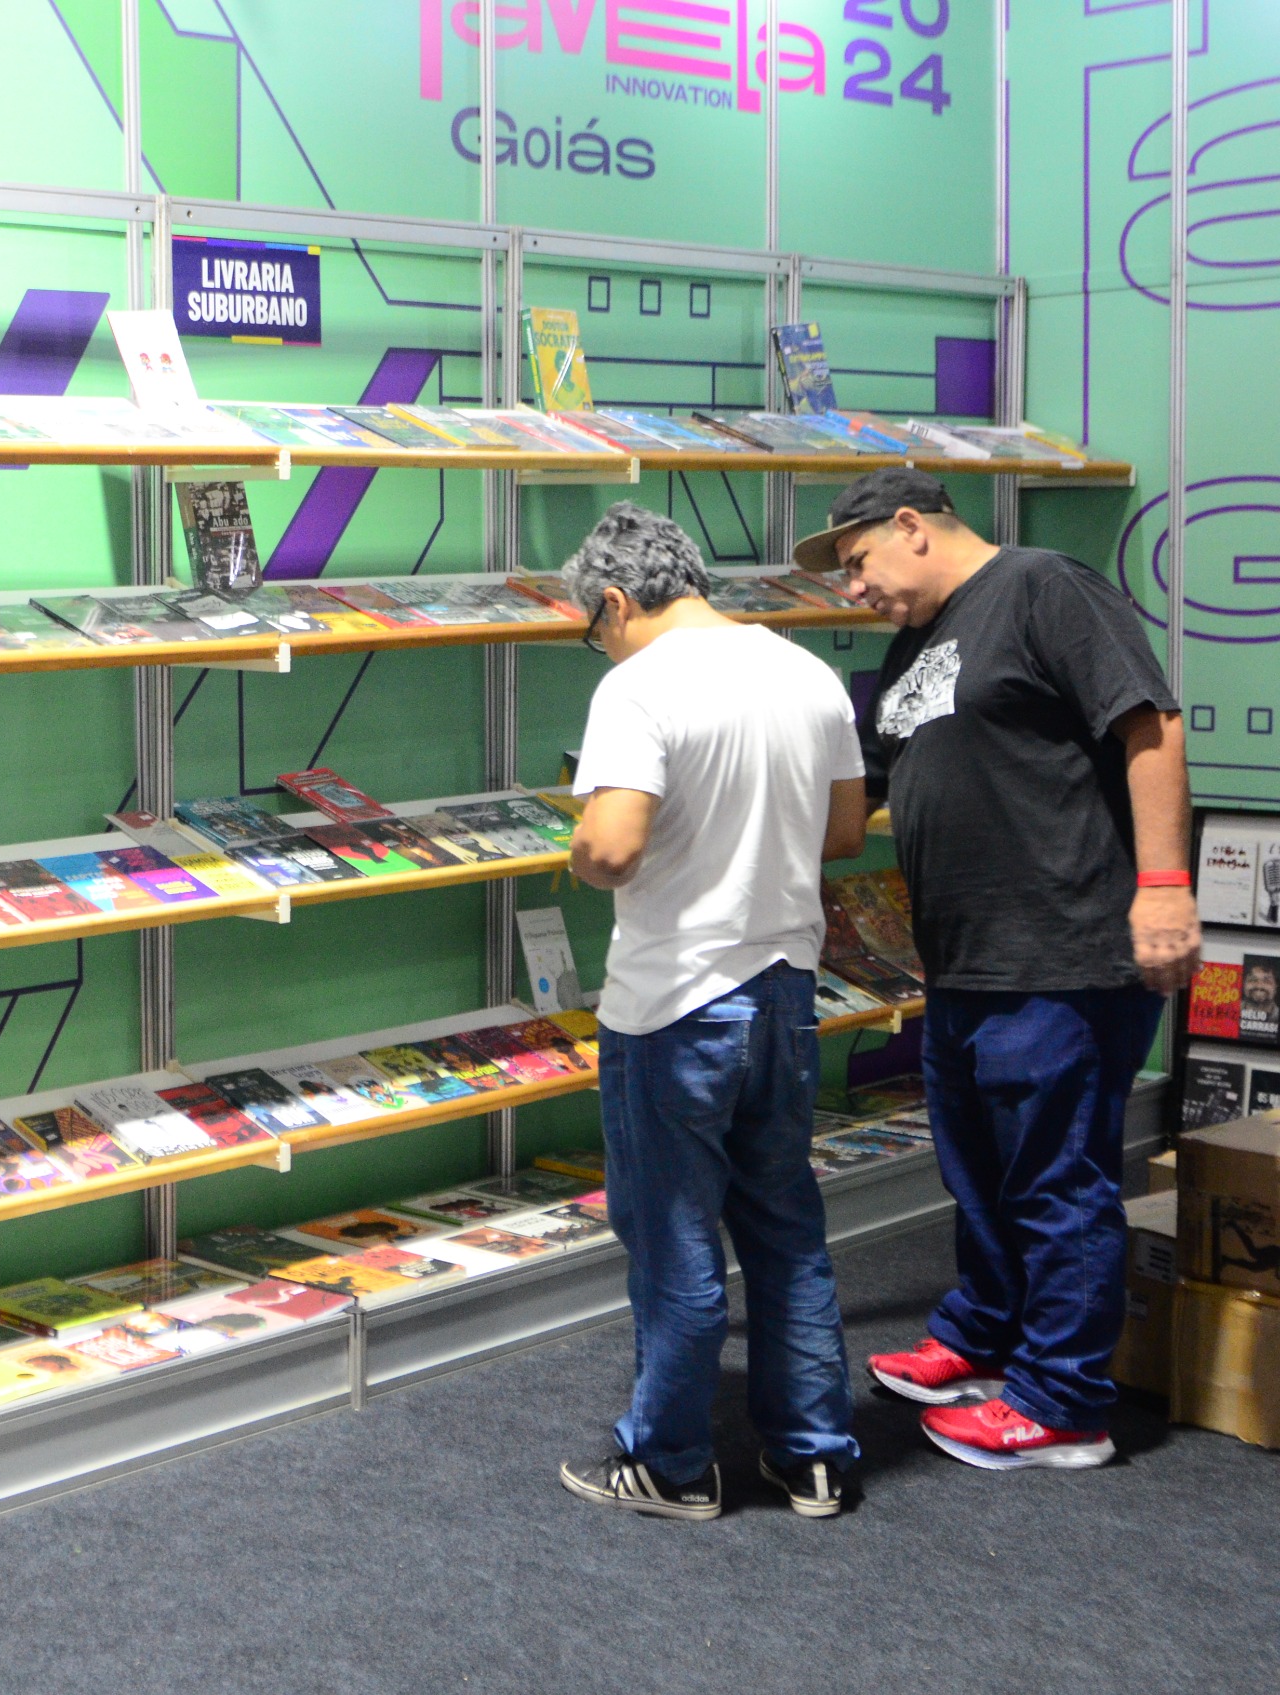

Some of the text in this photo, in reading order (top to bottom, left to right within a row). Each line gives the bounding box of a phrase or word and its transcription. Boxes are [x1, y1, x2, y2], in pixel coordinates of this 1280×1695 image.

[605, 73, 733, 111] INNOVATION
[842, 38, 951, 116] 24
[451, 104, 656, 181] Goiás
[201, 257, 295, 294] LIVRARIA
[187, 291, 308, 327] SUBURBANO
[1002, 1421, 1045, 1445] FILA
